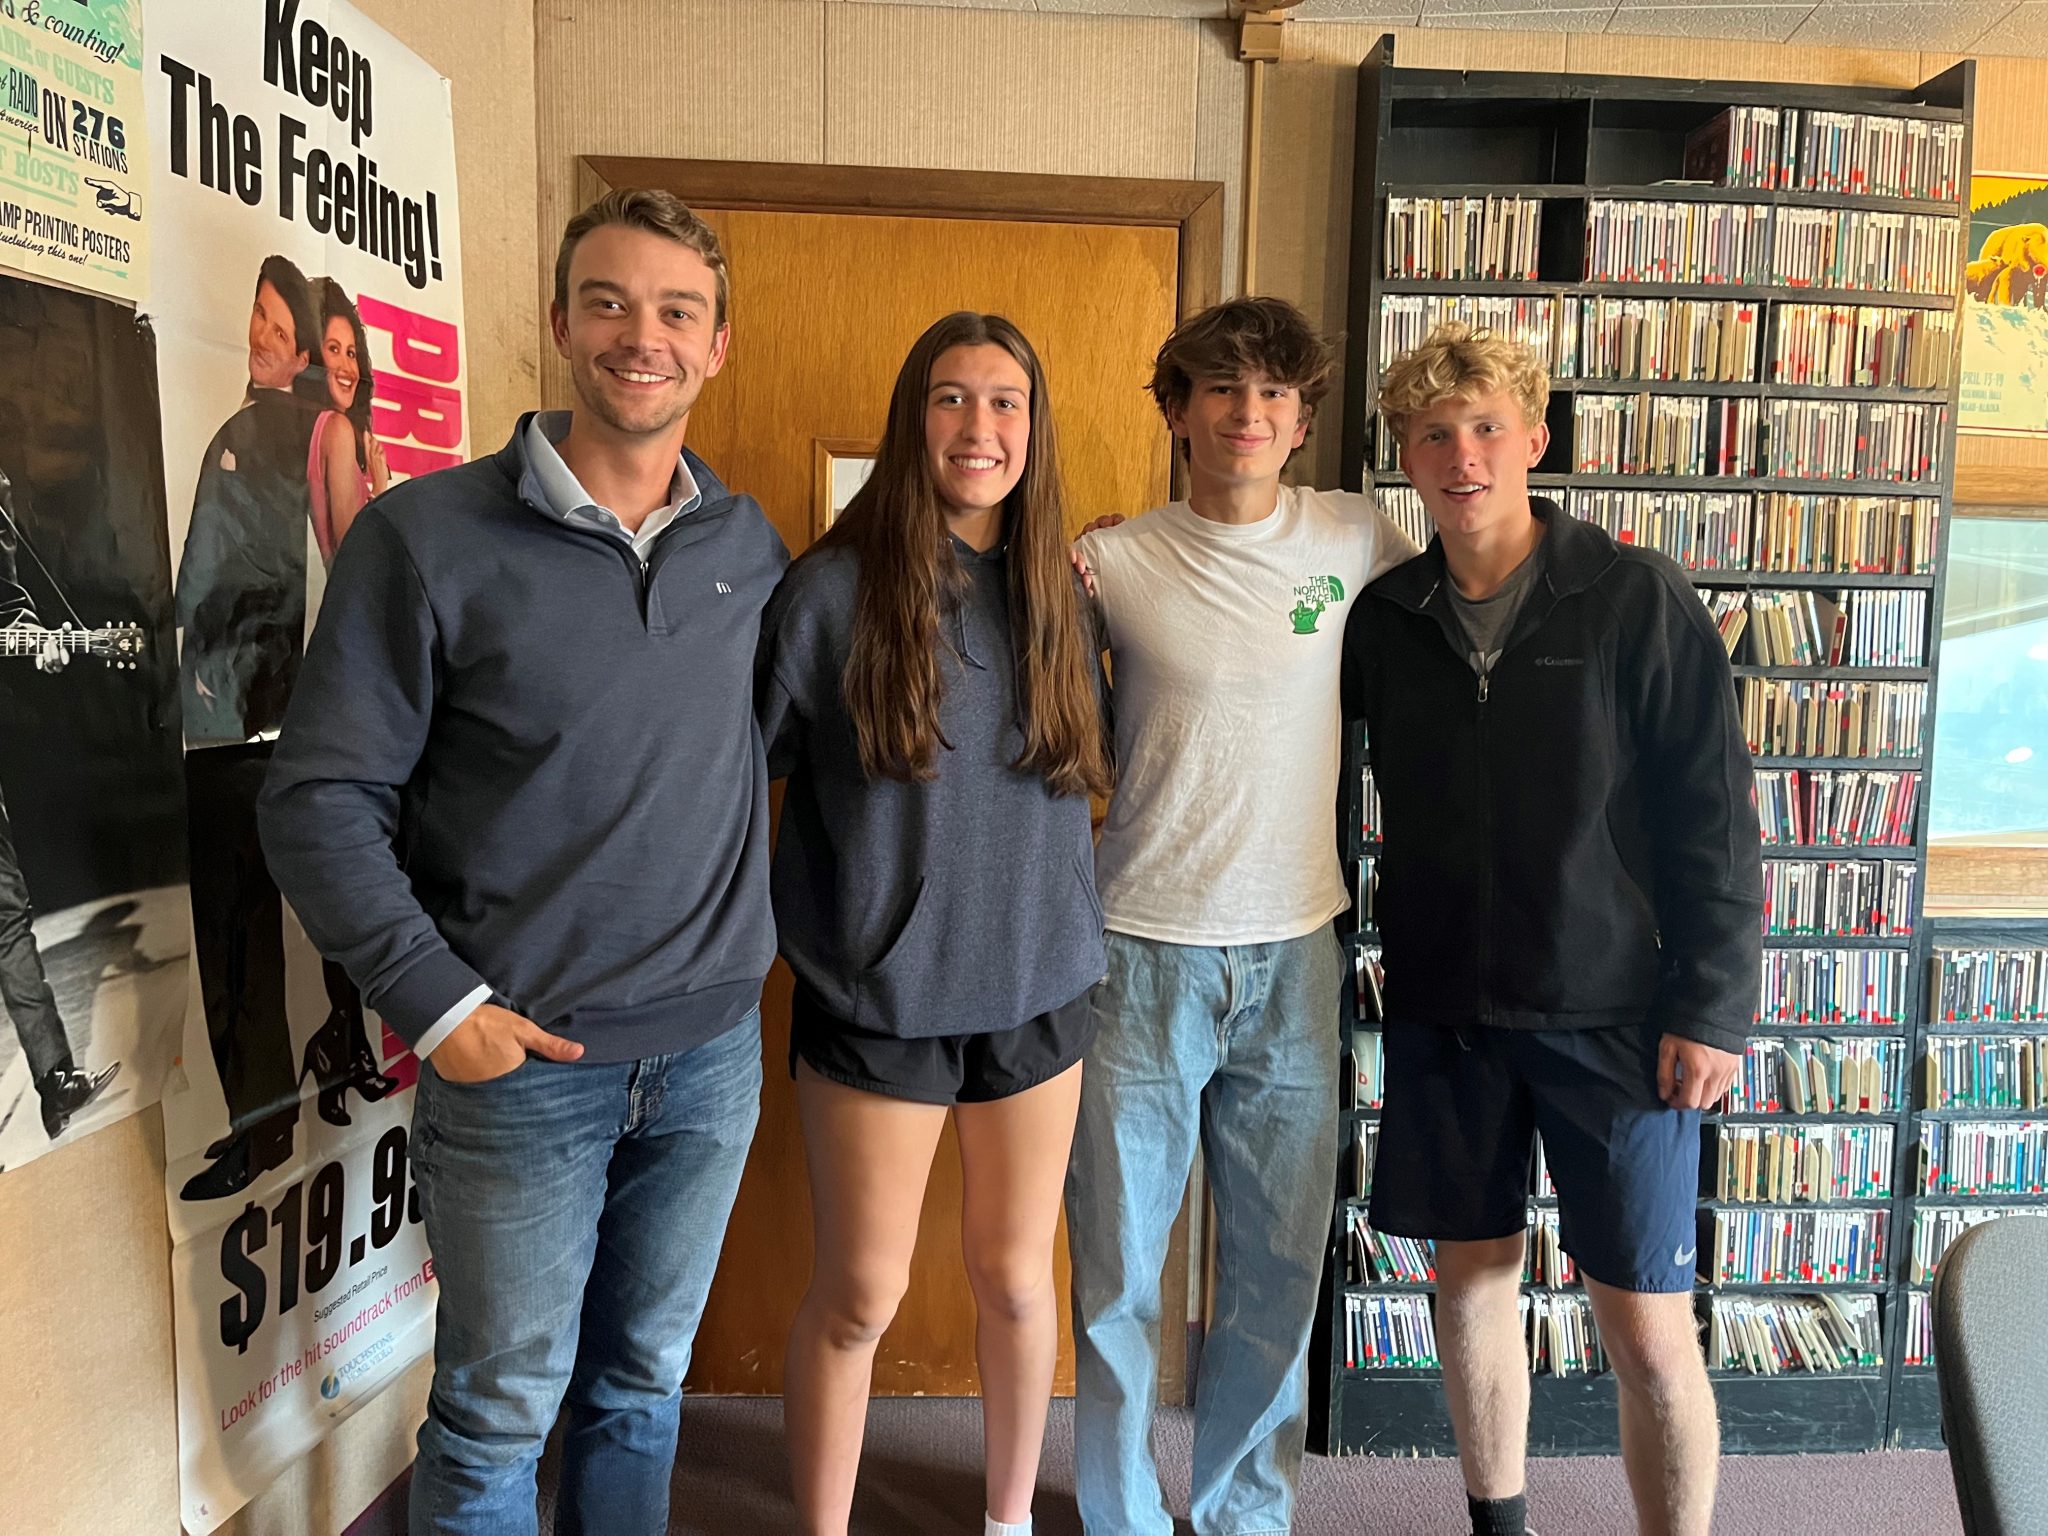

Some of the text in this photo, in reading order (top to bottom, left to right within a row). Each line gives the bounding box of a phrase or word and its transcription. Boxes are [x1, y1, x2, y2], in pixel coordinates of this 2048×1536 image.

[44, 15, 125, 64] counting!
[52, 53, 115, 105] GUESTS
[264, 0, 373, 148] Keep
[42, 87, 69, 152] ON
[72, 99, 126, 149] 276
[15, 150, 80, 195] HOSTS
[72, 133, 128, 174] STATIONS
[160, 53, 443, 290] The Feeling!
[25, 208, 79, 248] PRINTING
[82, 226, 131, 264] POSTERS
[48, 243, 66, 260] this
[69, 253, 89, 266] one!
[1962, 371, 1981, 385] PRIL
[1293, 585, 1330, 596] NORTH
[1305, 594, 1331, 605] FACE
[1308, 575, 1328, 587] THE
[314, 1265, 388, 1322] Suggested Retail Price
[221, 1390, 257, 1431] Look
[258, 1375, 278, 1403] for
[280, 1359, 302, 1387] the
[304, 1342, 322, 1369] hit
[323, 1291, 393, 1355] soundtrack
[393, 1273, 422, 1304] from
[337, 1331, 395, 1378] TOUCHSTONE
